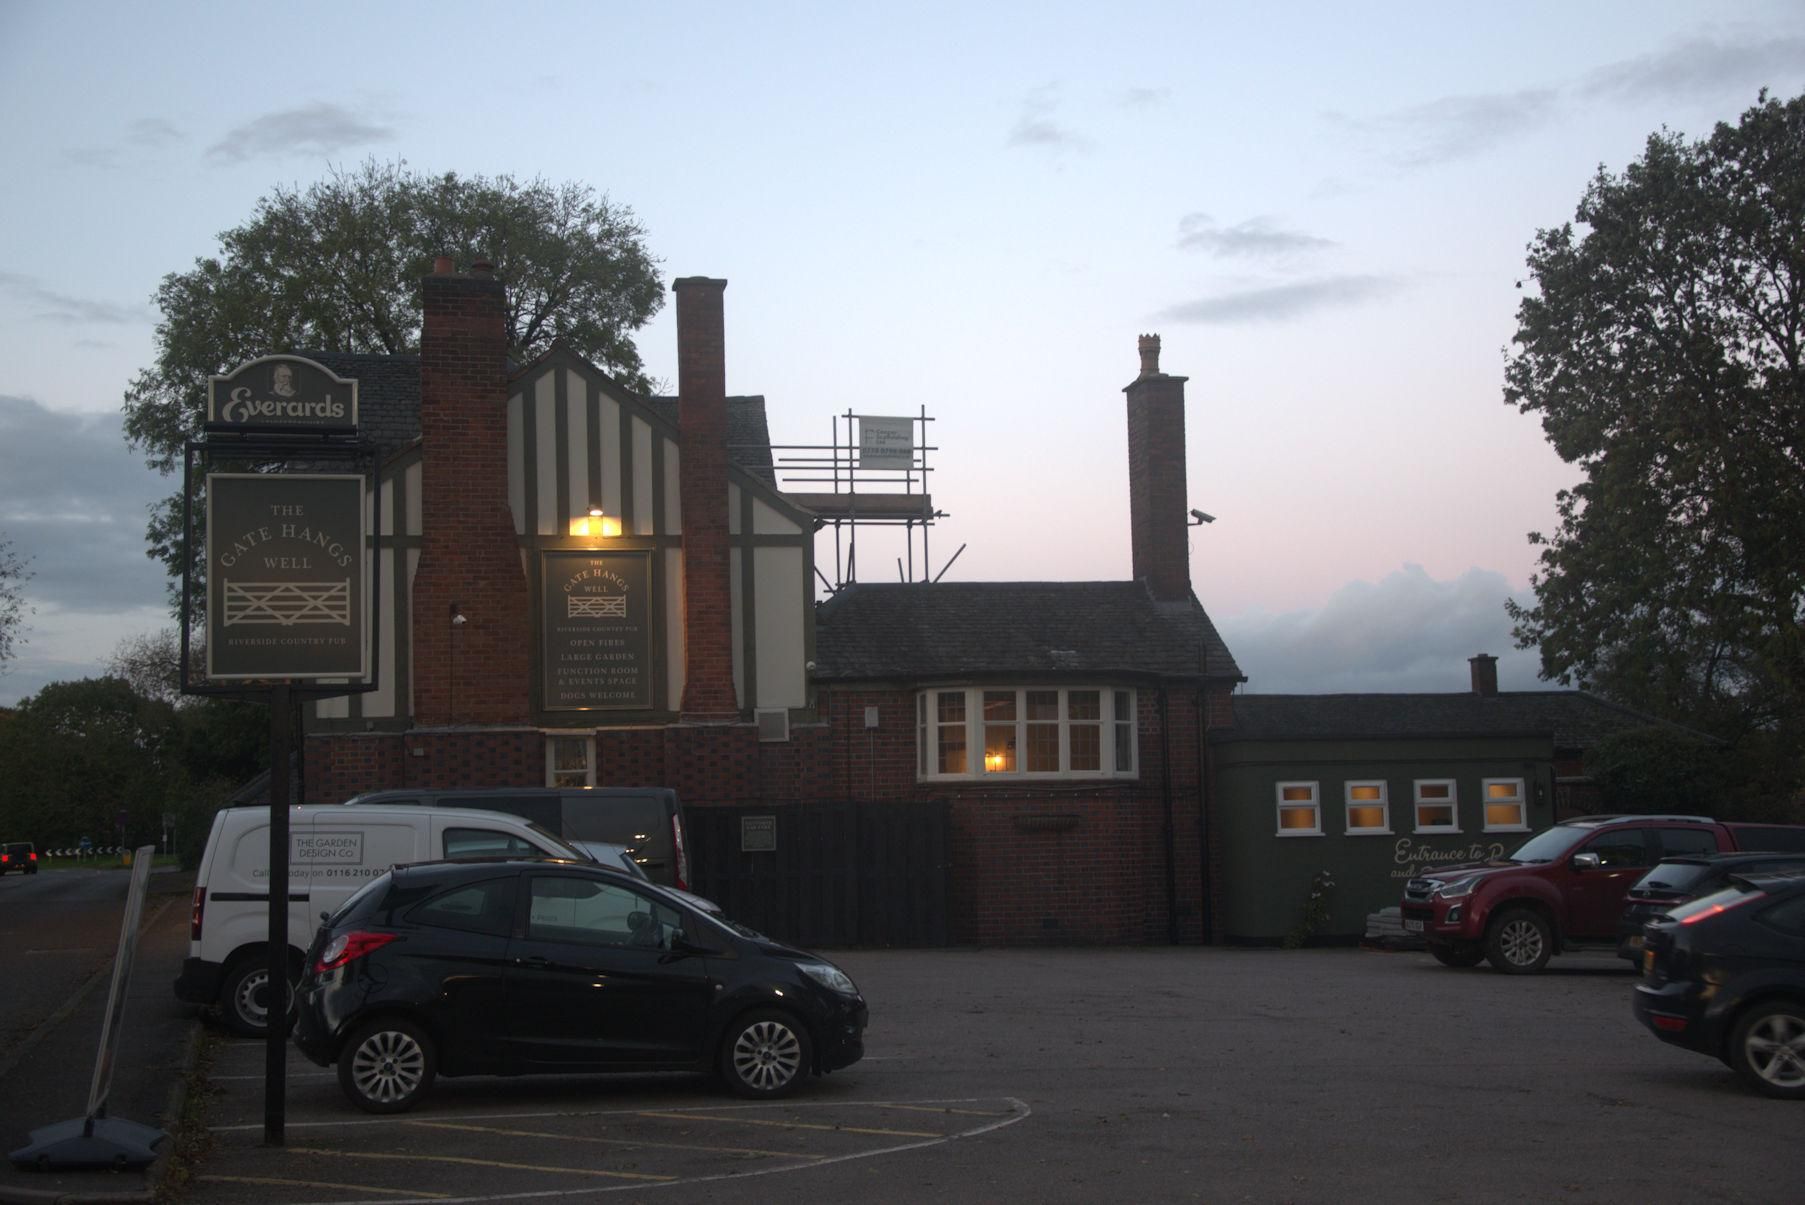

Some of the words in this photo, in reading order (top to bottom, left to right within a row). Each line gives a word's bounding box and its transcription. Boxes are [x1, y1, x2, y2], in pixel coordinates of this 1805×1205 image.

[222, 387, 345, 423] Everards
[271, 504, 304, 516] THE
[220, 526, 272, 568] GATE
[281, 523, 352, 568] HANGS
[264, 557, 312, 569] WELL
[563, 570, 590, 592] GATE
[593, 568, 630, 592] HANGS
[584, 585, 609, 593] WELL
[570, 639, 595, 647] OPEN
[560, 653, 592, 661] LARGE
[595, 652, 635, 660] GARDEN
[557, 667, 608, 675] FUNCTION
[607, 677, 637, 685] SPACE
[296, 839, 313, 848] THE
[315, 839, 357, 848] GARDEN
[300, 849, 336, 858] DESIGN
[1394, 838, 1467, 864] Entrance
[1469, 844, 1484, 860] to
[287, 868, 309, 881] oday
[326, 868, 350, 877] 0116
[353, 868, 370, 877] 210
